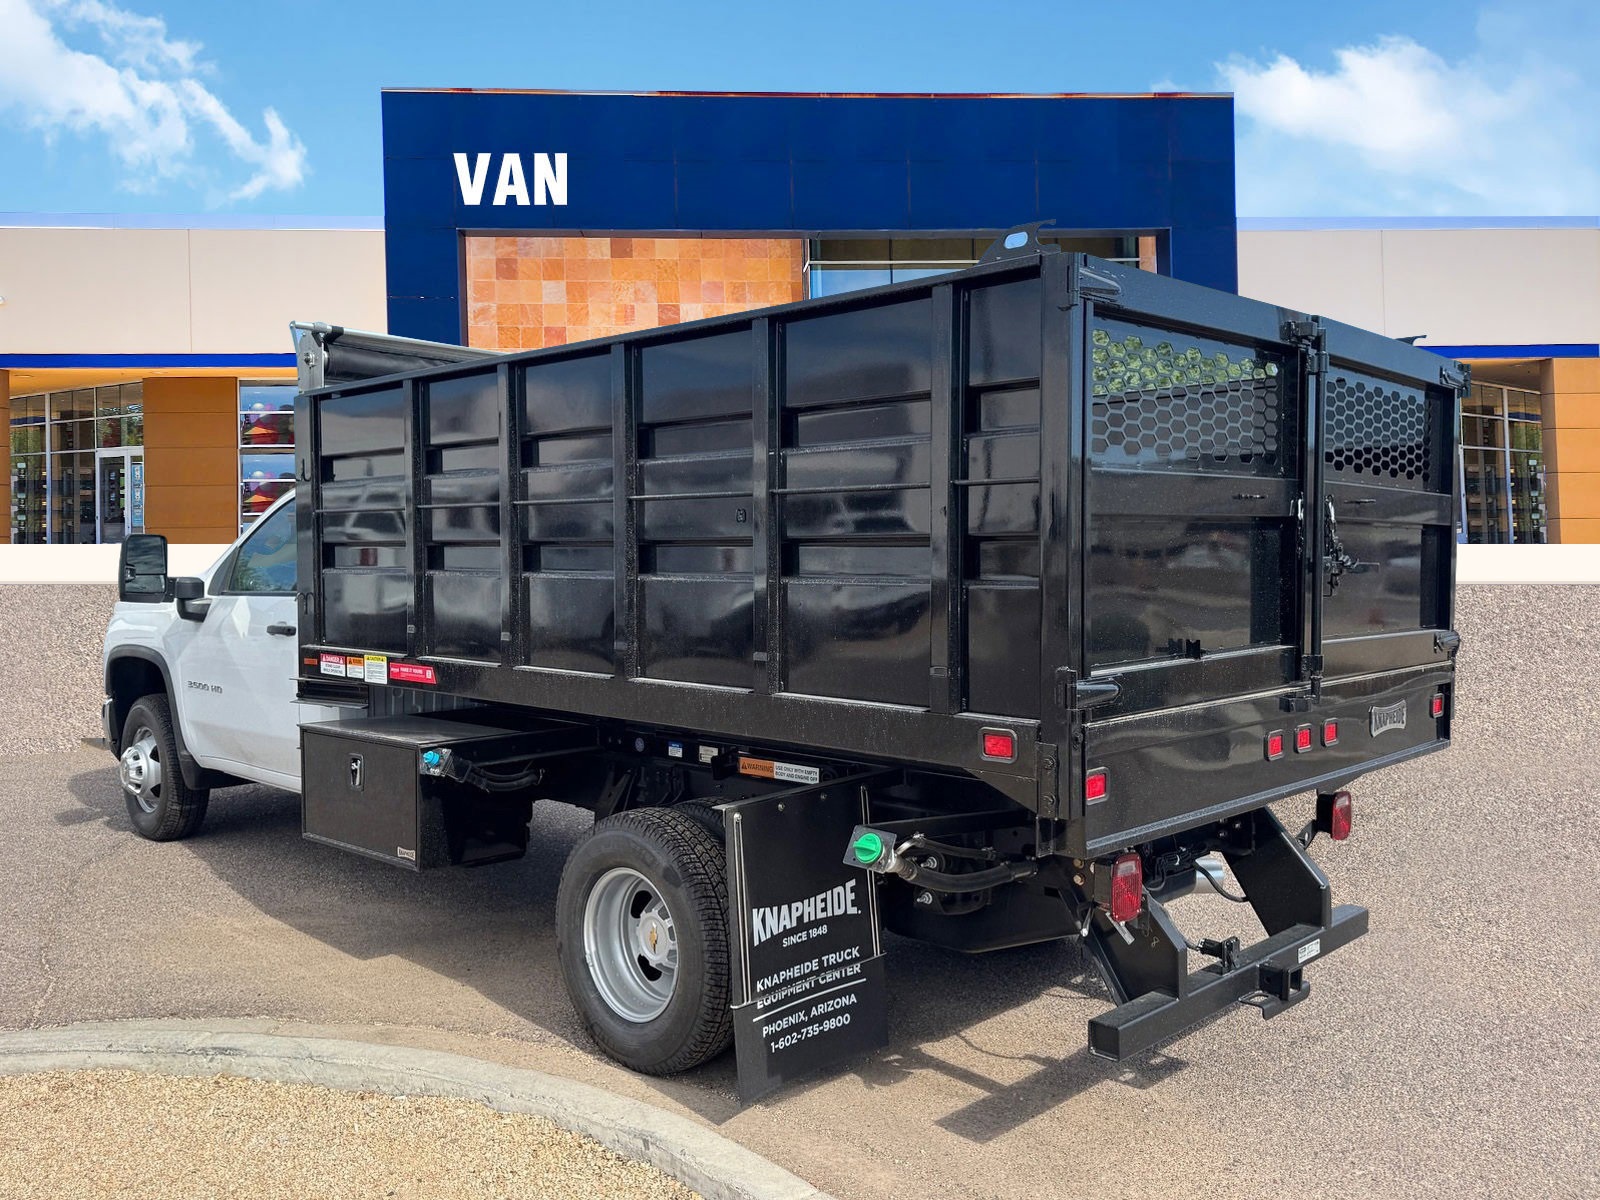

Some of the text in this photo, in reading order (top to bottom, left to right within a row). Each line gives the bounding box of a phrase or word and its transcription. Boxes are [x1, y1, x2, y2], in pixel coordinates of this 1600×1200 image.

[453, 152, 568, 206] VAN
[326, 656, 341, 664] DANGER
[187, 680, 223, 694] 3500 HD
[747, 762, 774, 773] WARNING
[794, 773, 810, 781] ENGINE
[804, 769, 818, 777] EMPTY
[782, 924, 828, 947] SINCE 1848
[756, 946, 860, 993] KNAPHEIDE TRUCK
[756, 963, 861, 1010] EQUIPMENT CENTER
[762, 993, 857, 1038] PHOENIX, ARIZONA
[770, 1013, 851, 1053] 1-602-735-9800
